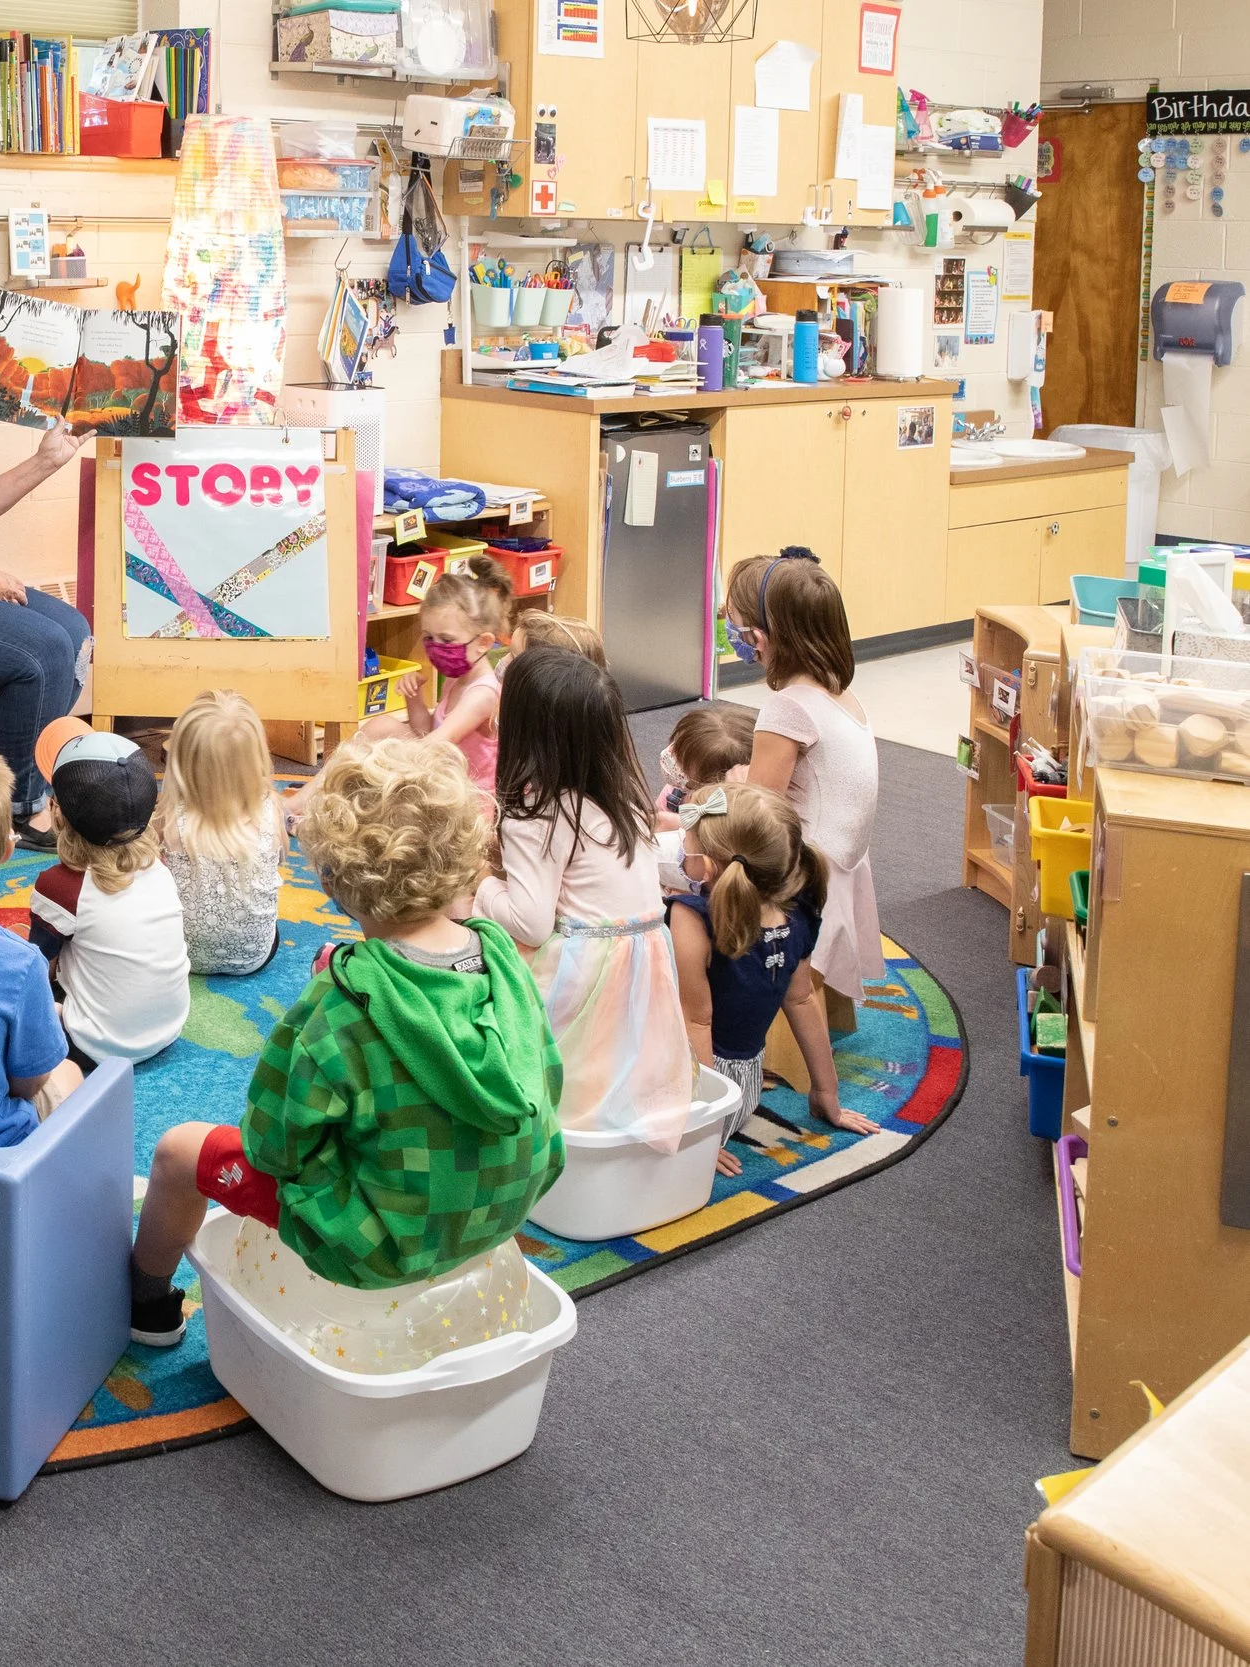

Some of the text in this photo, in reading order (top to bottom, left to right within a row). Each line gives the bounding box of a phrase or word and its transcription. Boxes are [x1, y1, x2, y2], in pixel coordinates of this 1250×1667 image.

[1152, 95, 1250, 120] Birthda
[131, 462, 321, 507] STORY
[458, 959, 478, 970] JINX
